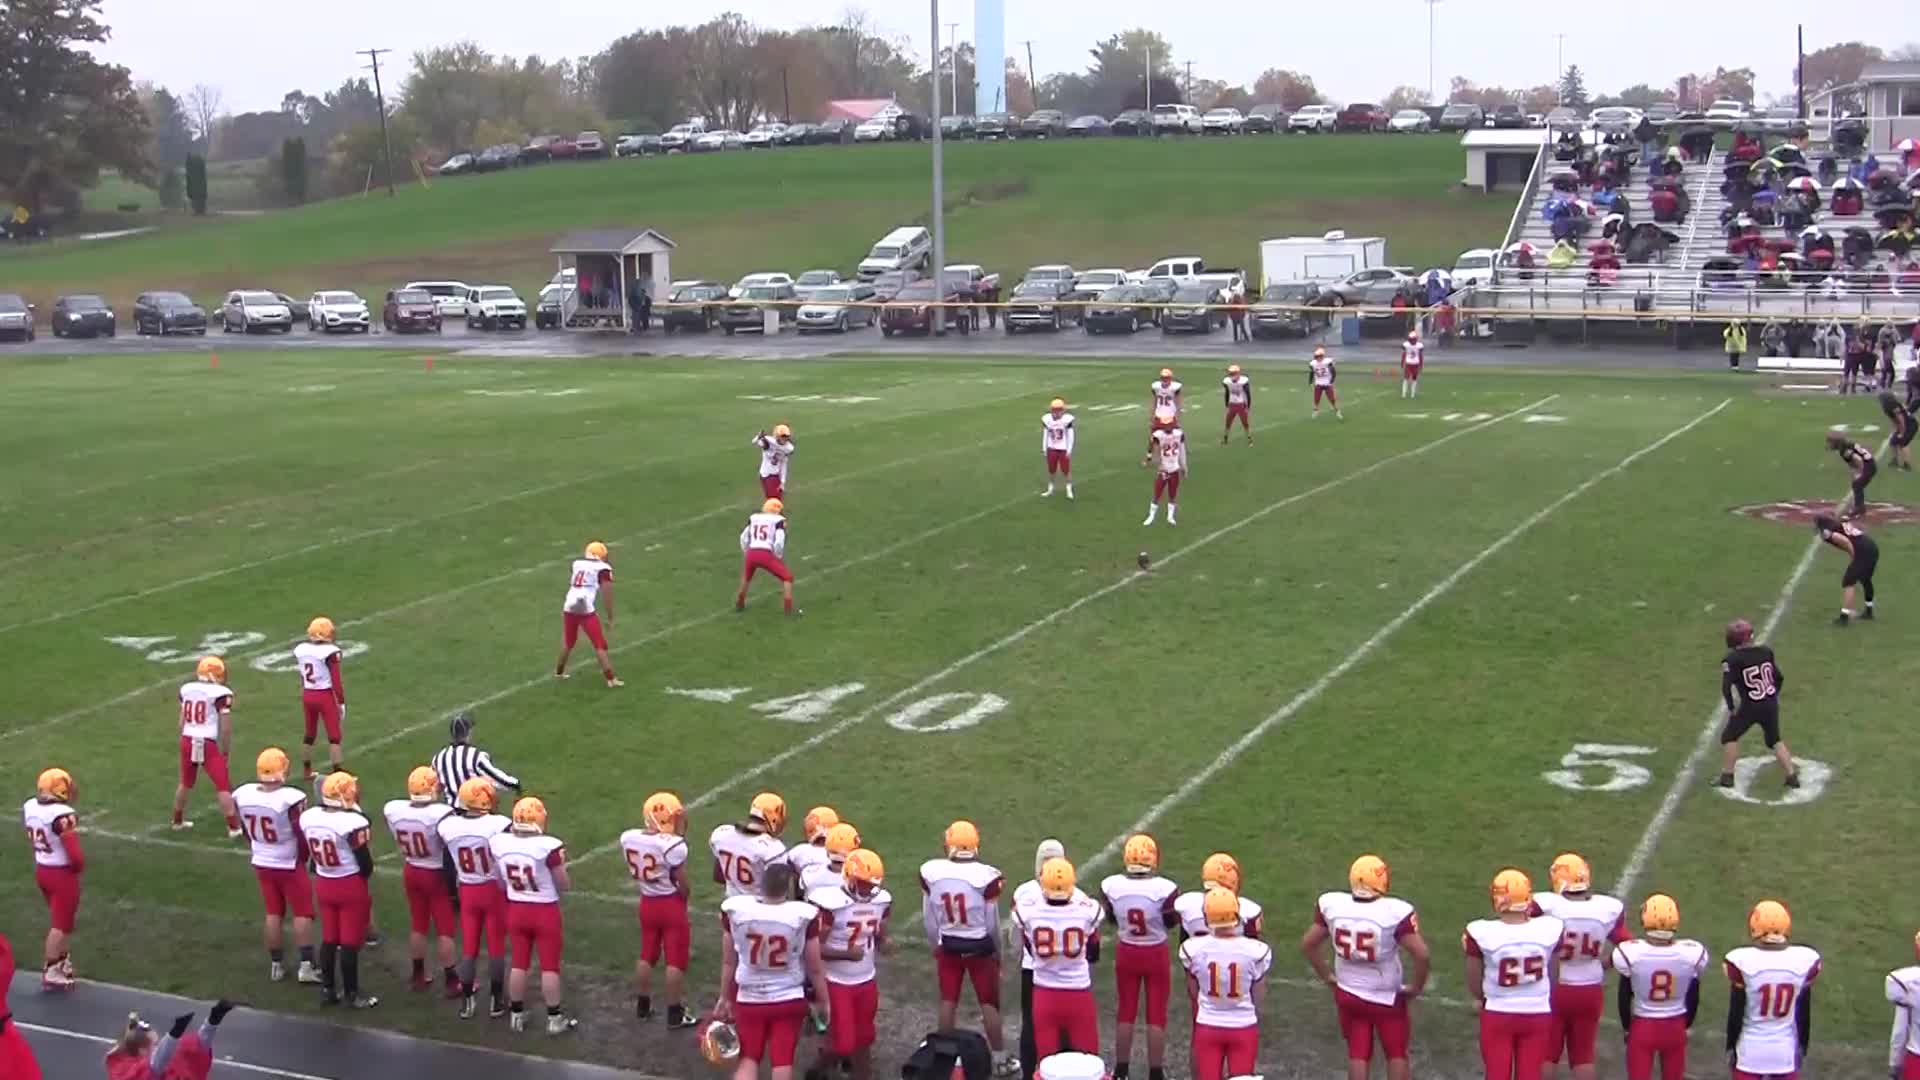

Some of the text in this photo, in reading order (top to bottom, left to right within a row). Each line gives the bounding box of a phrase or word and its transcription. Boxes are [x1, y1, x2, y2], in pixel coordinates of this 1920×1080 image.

[752, 524, 769, 542] 15
[303, 662, 316, 684] 2
[1742, 661, 1777, 701] 50
[184, 700, 207, 725] 88
[749, 682, 1008, 733] 40
[1541, 742, 1833, 807] 50
[242, 813, 279, 844] 76
[396, 830, 430, 858] 50
[308, 837, 341, 867] 68
[458, 847, 491, 874] 81
[626, 849, 660, 883] 52
[718, 849, 755, 884] 76
[506, 864, 541, 892] 51
[940, 891, 969, 926] 11
[1126, 907, 1147, 936] 9
[745, 933, 788, 968] 72
[1032, 926, 1085, 959] 80
[1334, 928, 1376, 962] 55
[1559, 930, 1601, 961] 54
[1206, 961, 1242, 999] 11
[1498, 955, 1544, 988] 65
[1649, 969, 1674, 1003] 8
[1757, 983, 1797, 1019] 10
